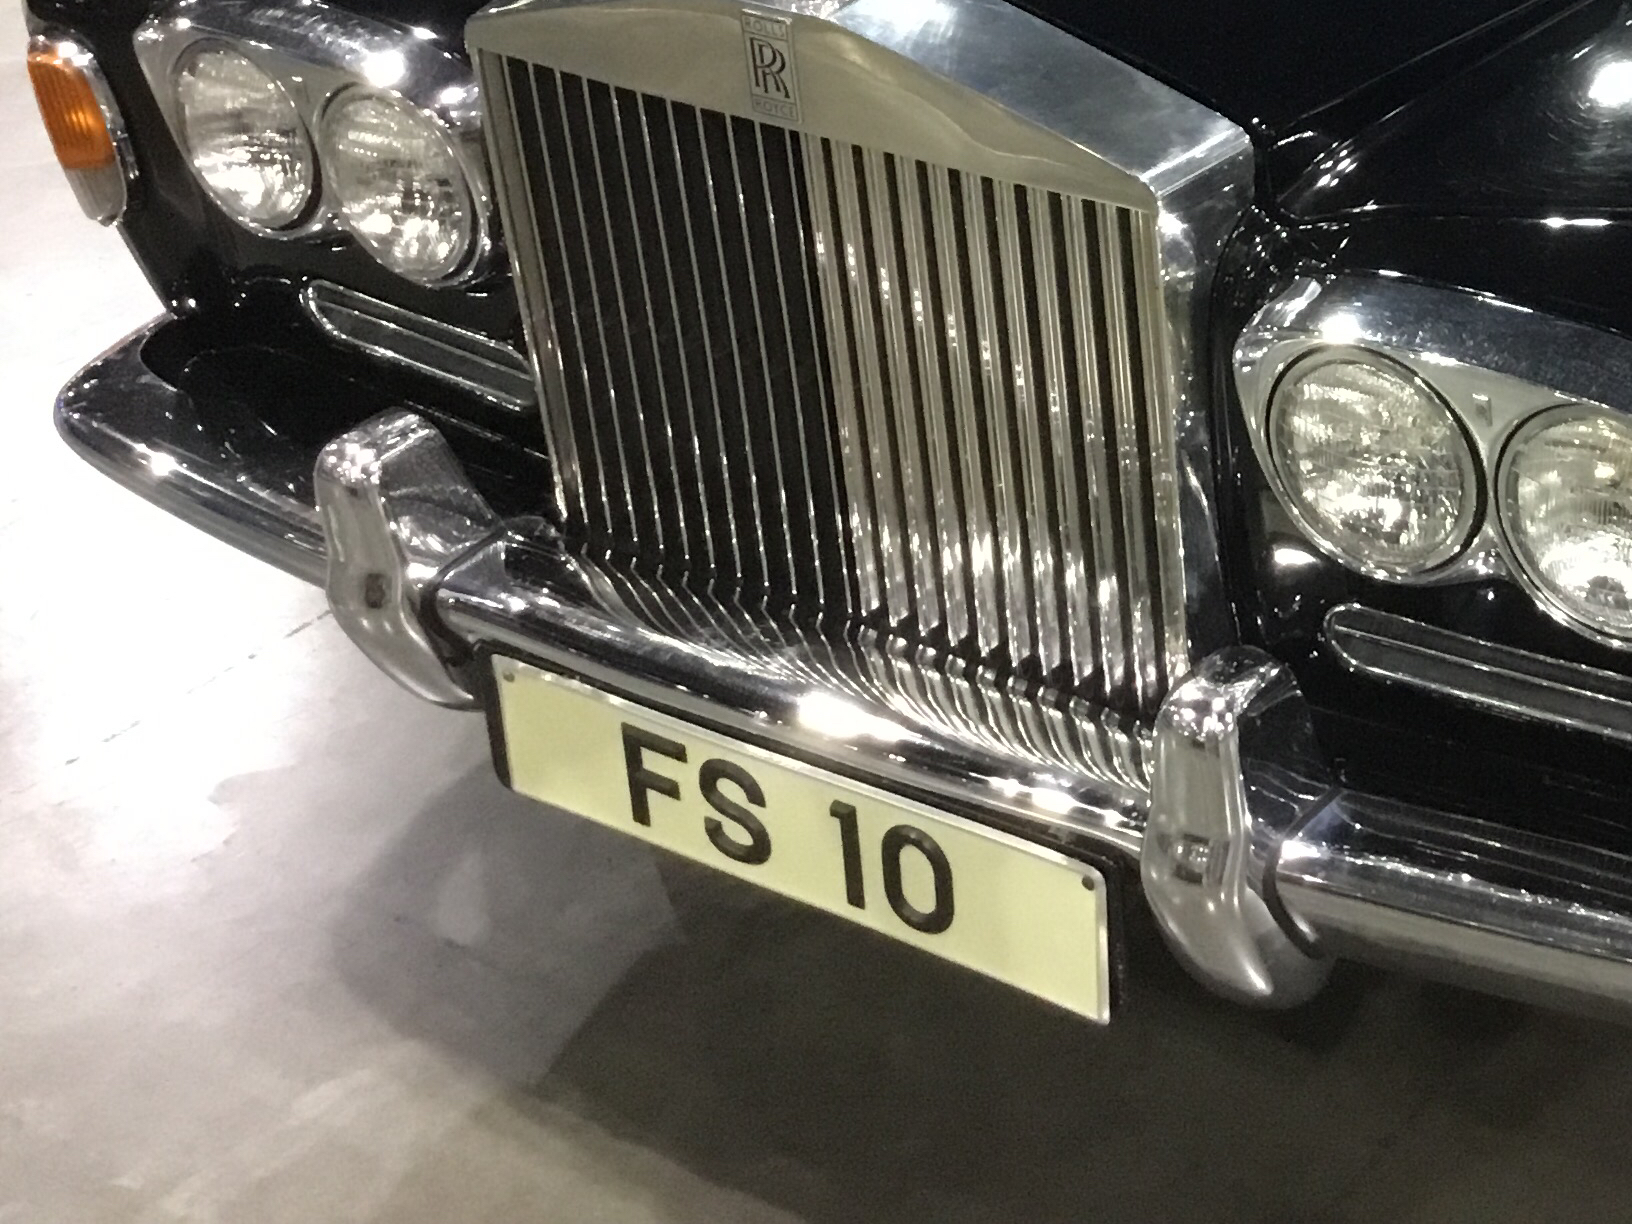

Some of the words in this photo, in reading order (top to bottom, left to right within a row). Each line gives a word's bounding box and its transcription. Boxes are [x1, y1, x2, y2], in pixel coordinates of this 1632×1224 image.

[744, 17, 786, 38] ROLLS
[754, 98, 796, 118] ROYCE
[621, 721, 772, 866] FS
[829, 800, 955, 935] 10
